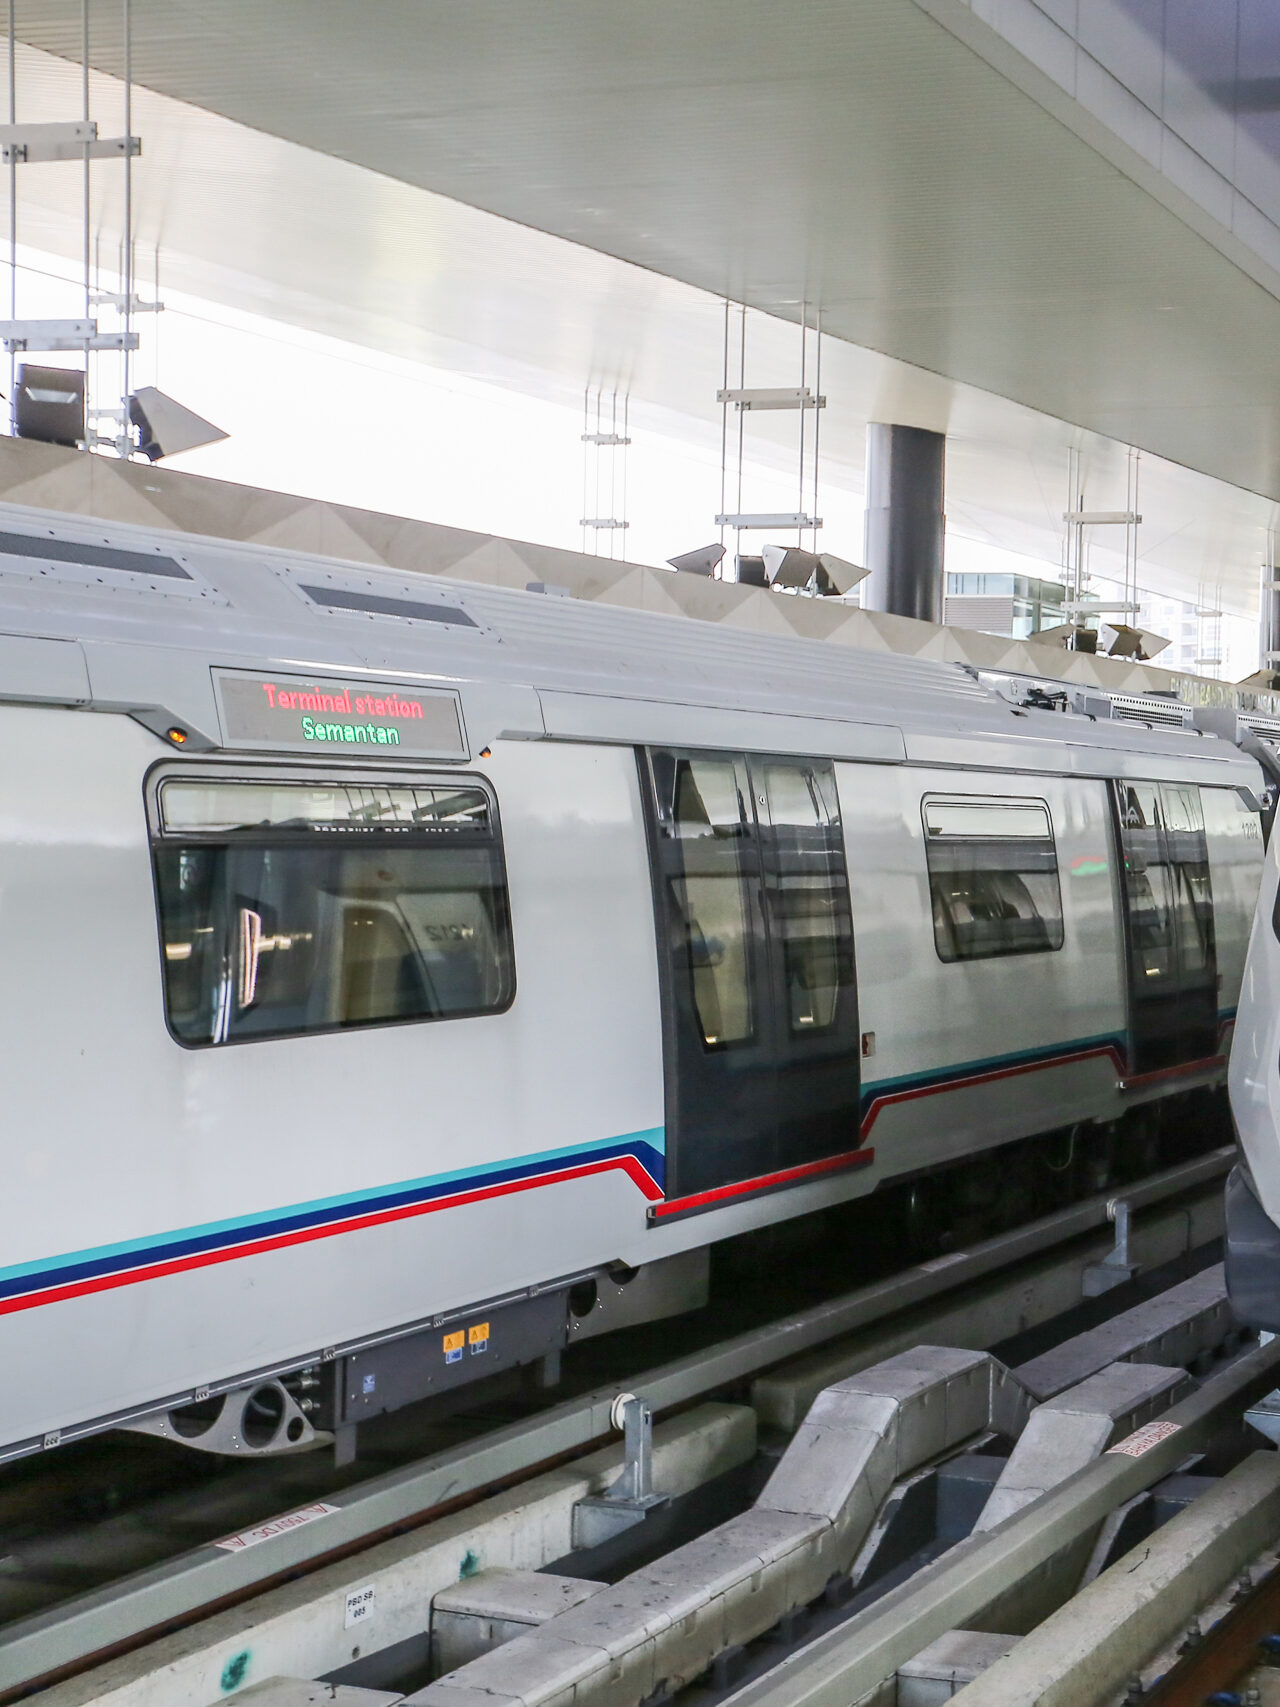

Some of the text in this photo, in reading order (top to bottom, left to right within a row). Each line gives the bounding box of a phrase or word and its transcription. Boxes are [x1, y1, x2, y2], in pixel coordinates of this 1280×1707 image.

[262, 684, 424, 719] Terminal station
[301, 715, 400, 745] Semantan
